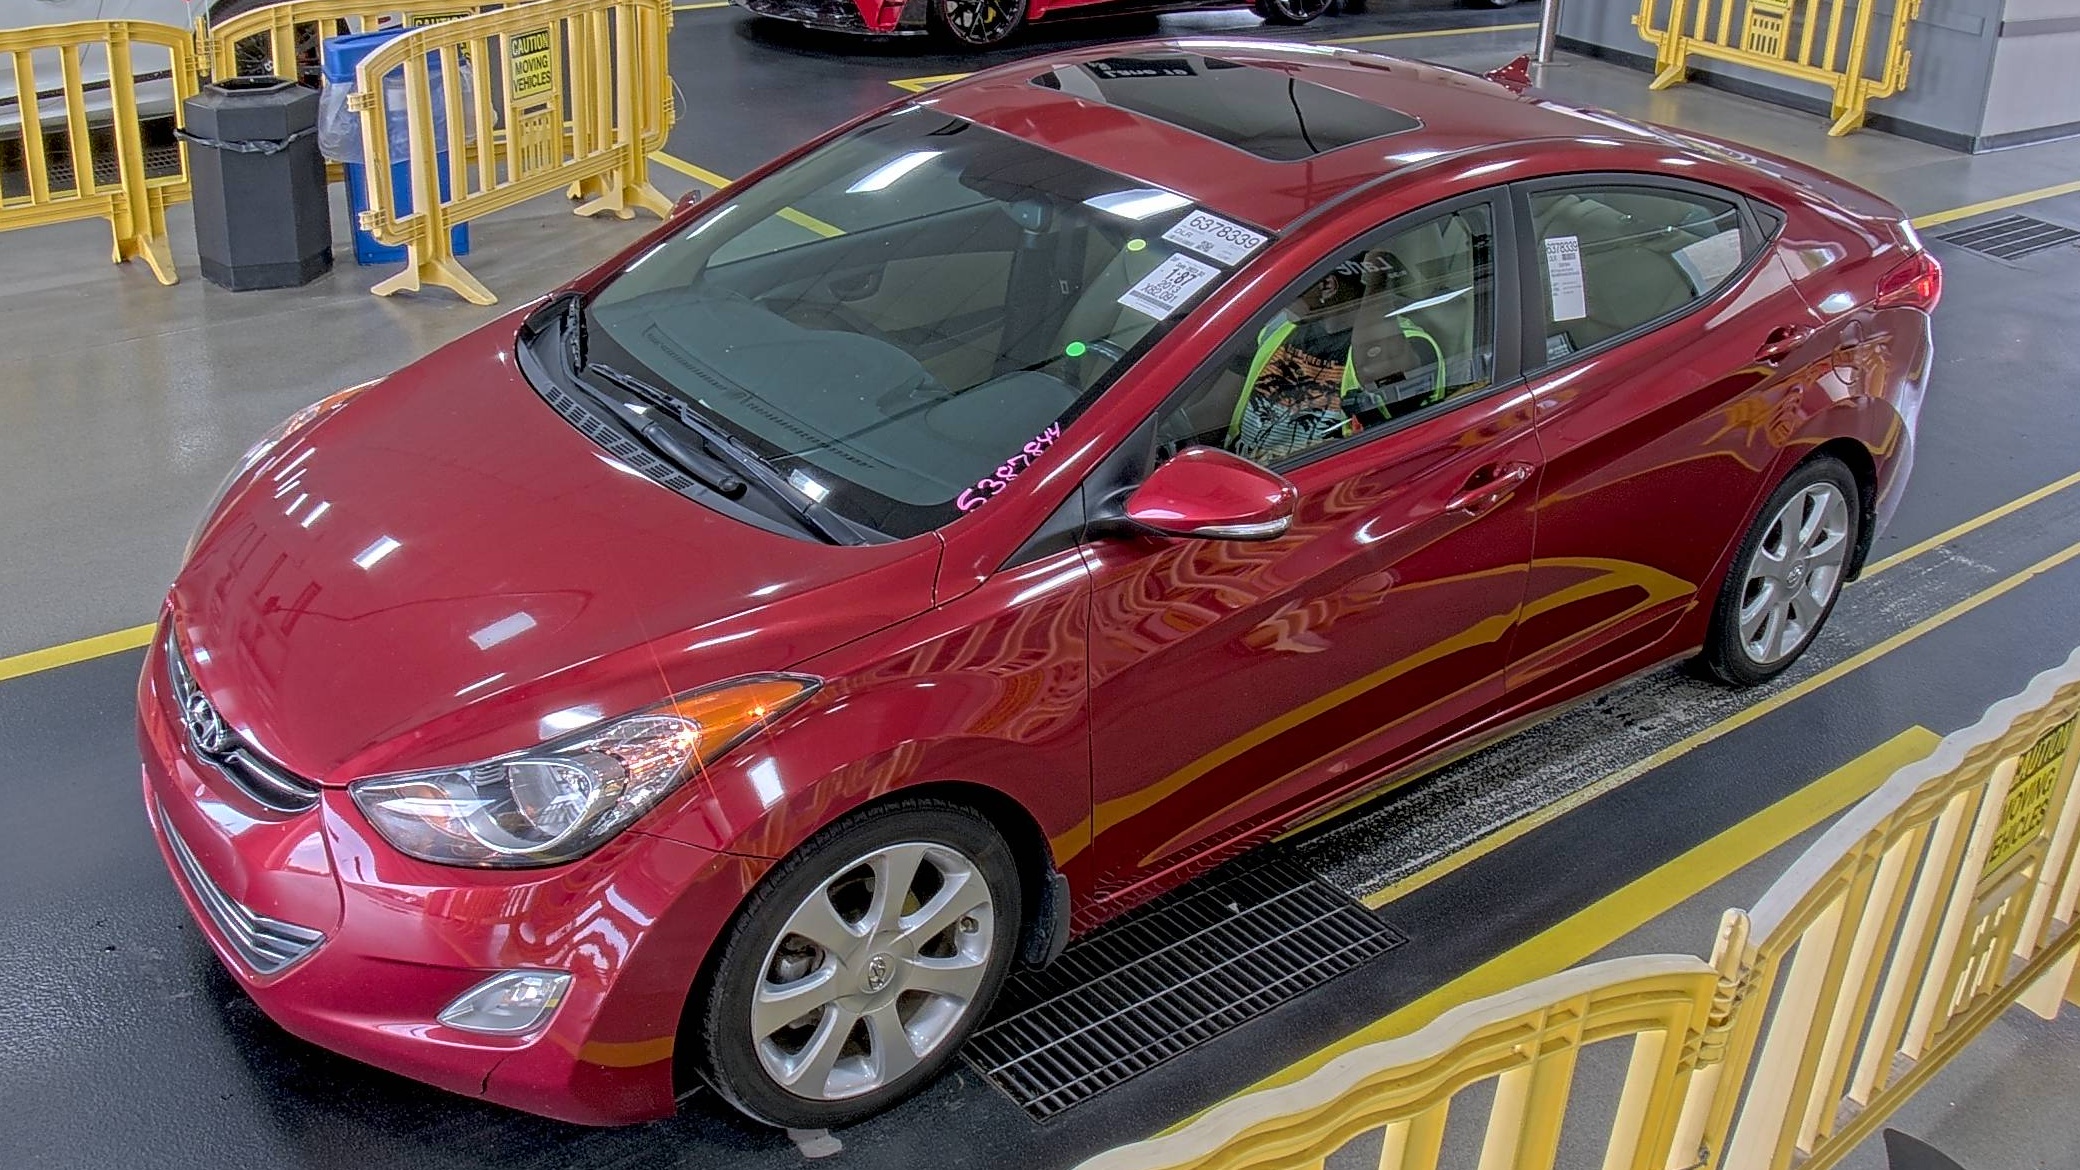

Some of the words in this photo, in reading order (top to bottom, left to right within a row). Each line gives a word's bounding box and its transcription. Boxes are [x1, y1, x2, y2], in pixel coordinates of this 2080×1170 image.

[512, 32, 549, 55] CAUTION
[515, 54, 548, 75] MOVING
[513, 70, 551, 92] VEHICLES
[1189, 215, 1261, 249] 6378339
[1159, 279, 1182, 294] 2013
[1166, 267, 1198, 287] 1:87
[1989, 798, 2049, 863] EHICLES
